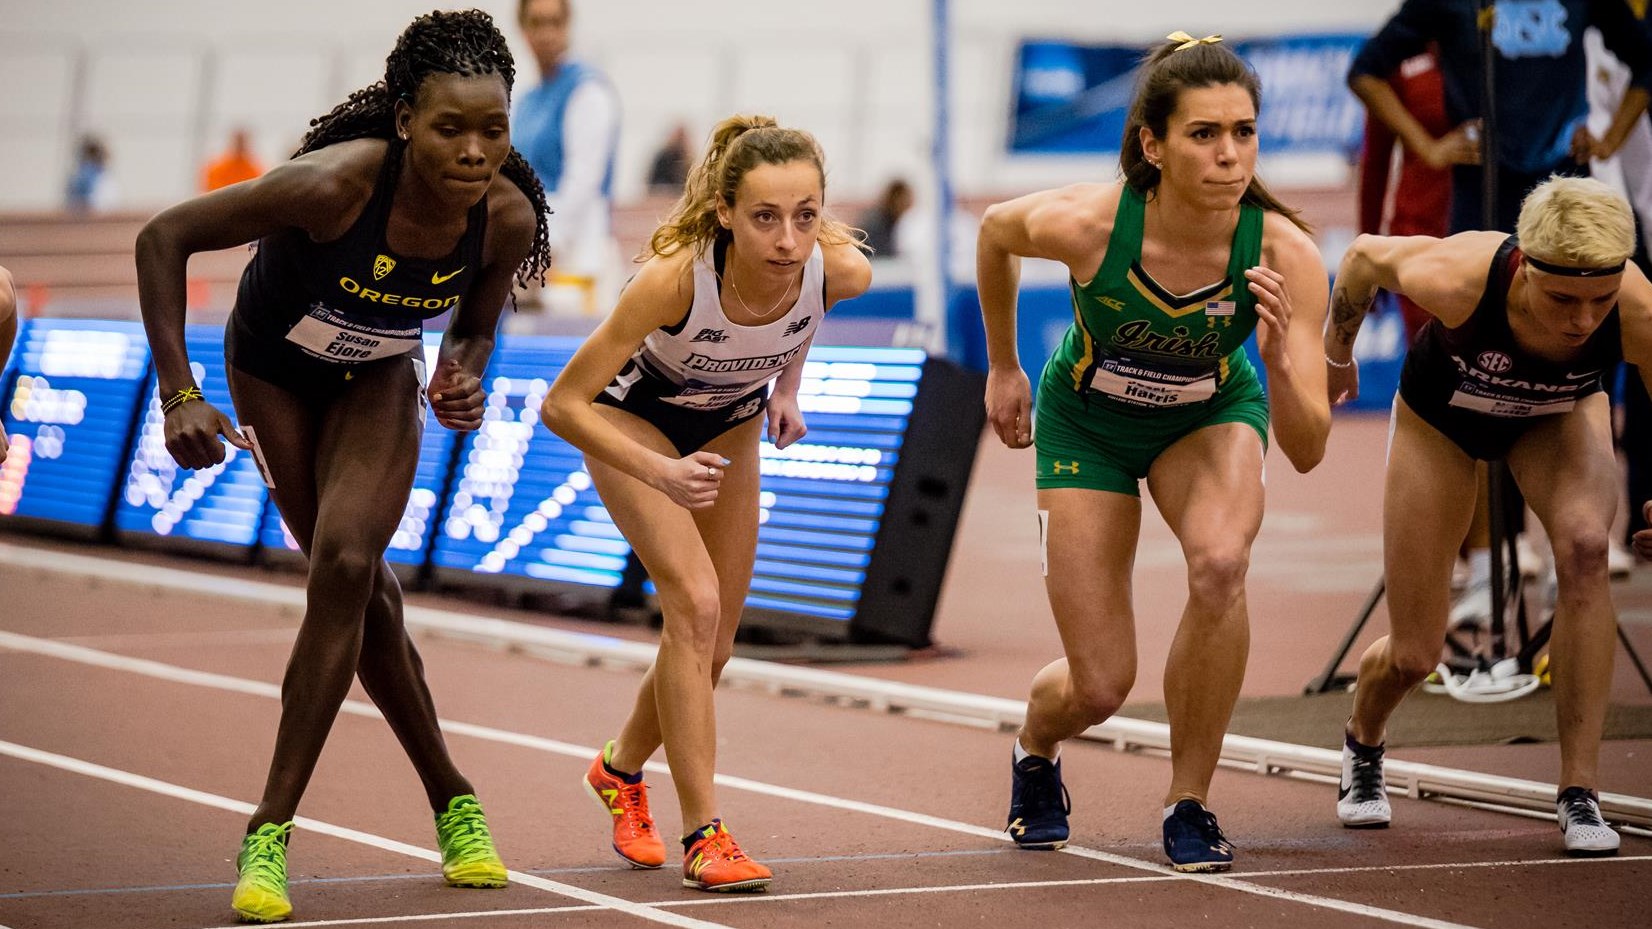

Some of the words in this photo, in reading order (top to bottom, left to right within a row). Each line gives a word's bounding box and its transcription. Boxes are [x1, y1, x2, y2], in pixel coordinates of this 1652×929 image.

[339, 276, 460, 309] OREGON
[1097, 297, 1126, 311] ACC
[326, 314, 346, 325] TRACK
[371, 326, 421, 337] CHAMPIONSHIPS
[700, 328, 724, 336] BIG
[336, 331, 380, 348] Susan
[694, 335, 730, 343] EAST
[1112, 320, 1223, 358] Irish
[325, 342, 372, 359] Ejore
[681, 342, 806, 372] PROVIDENC
[1480, 352, 1511, 371] SEC
[1116, 365, 1137, 375] TRACK
[1137, 369, 1143, 377] &
[1143, 370, 1162, 379] FIELD
[1451, 355, 1596, 392] ARKANS
[1125, 385, 1178, 403] Harris
